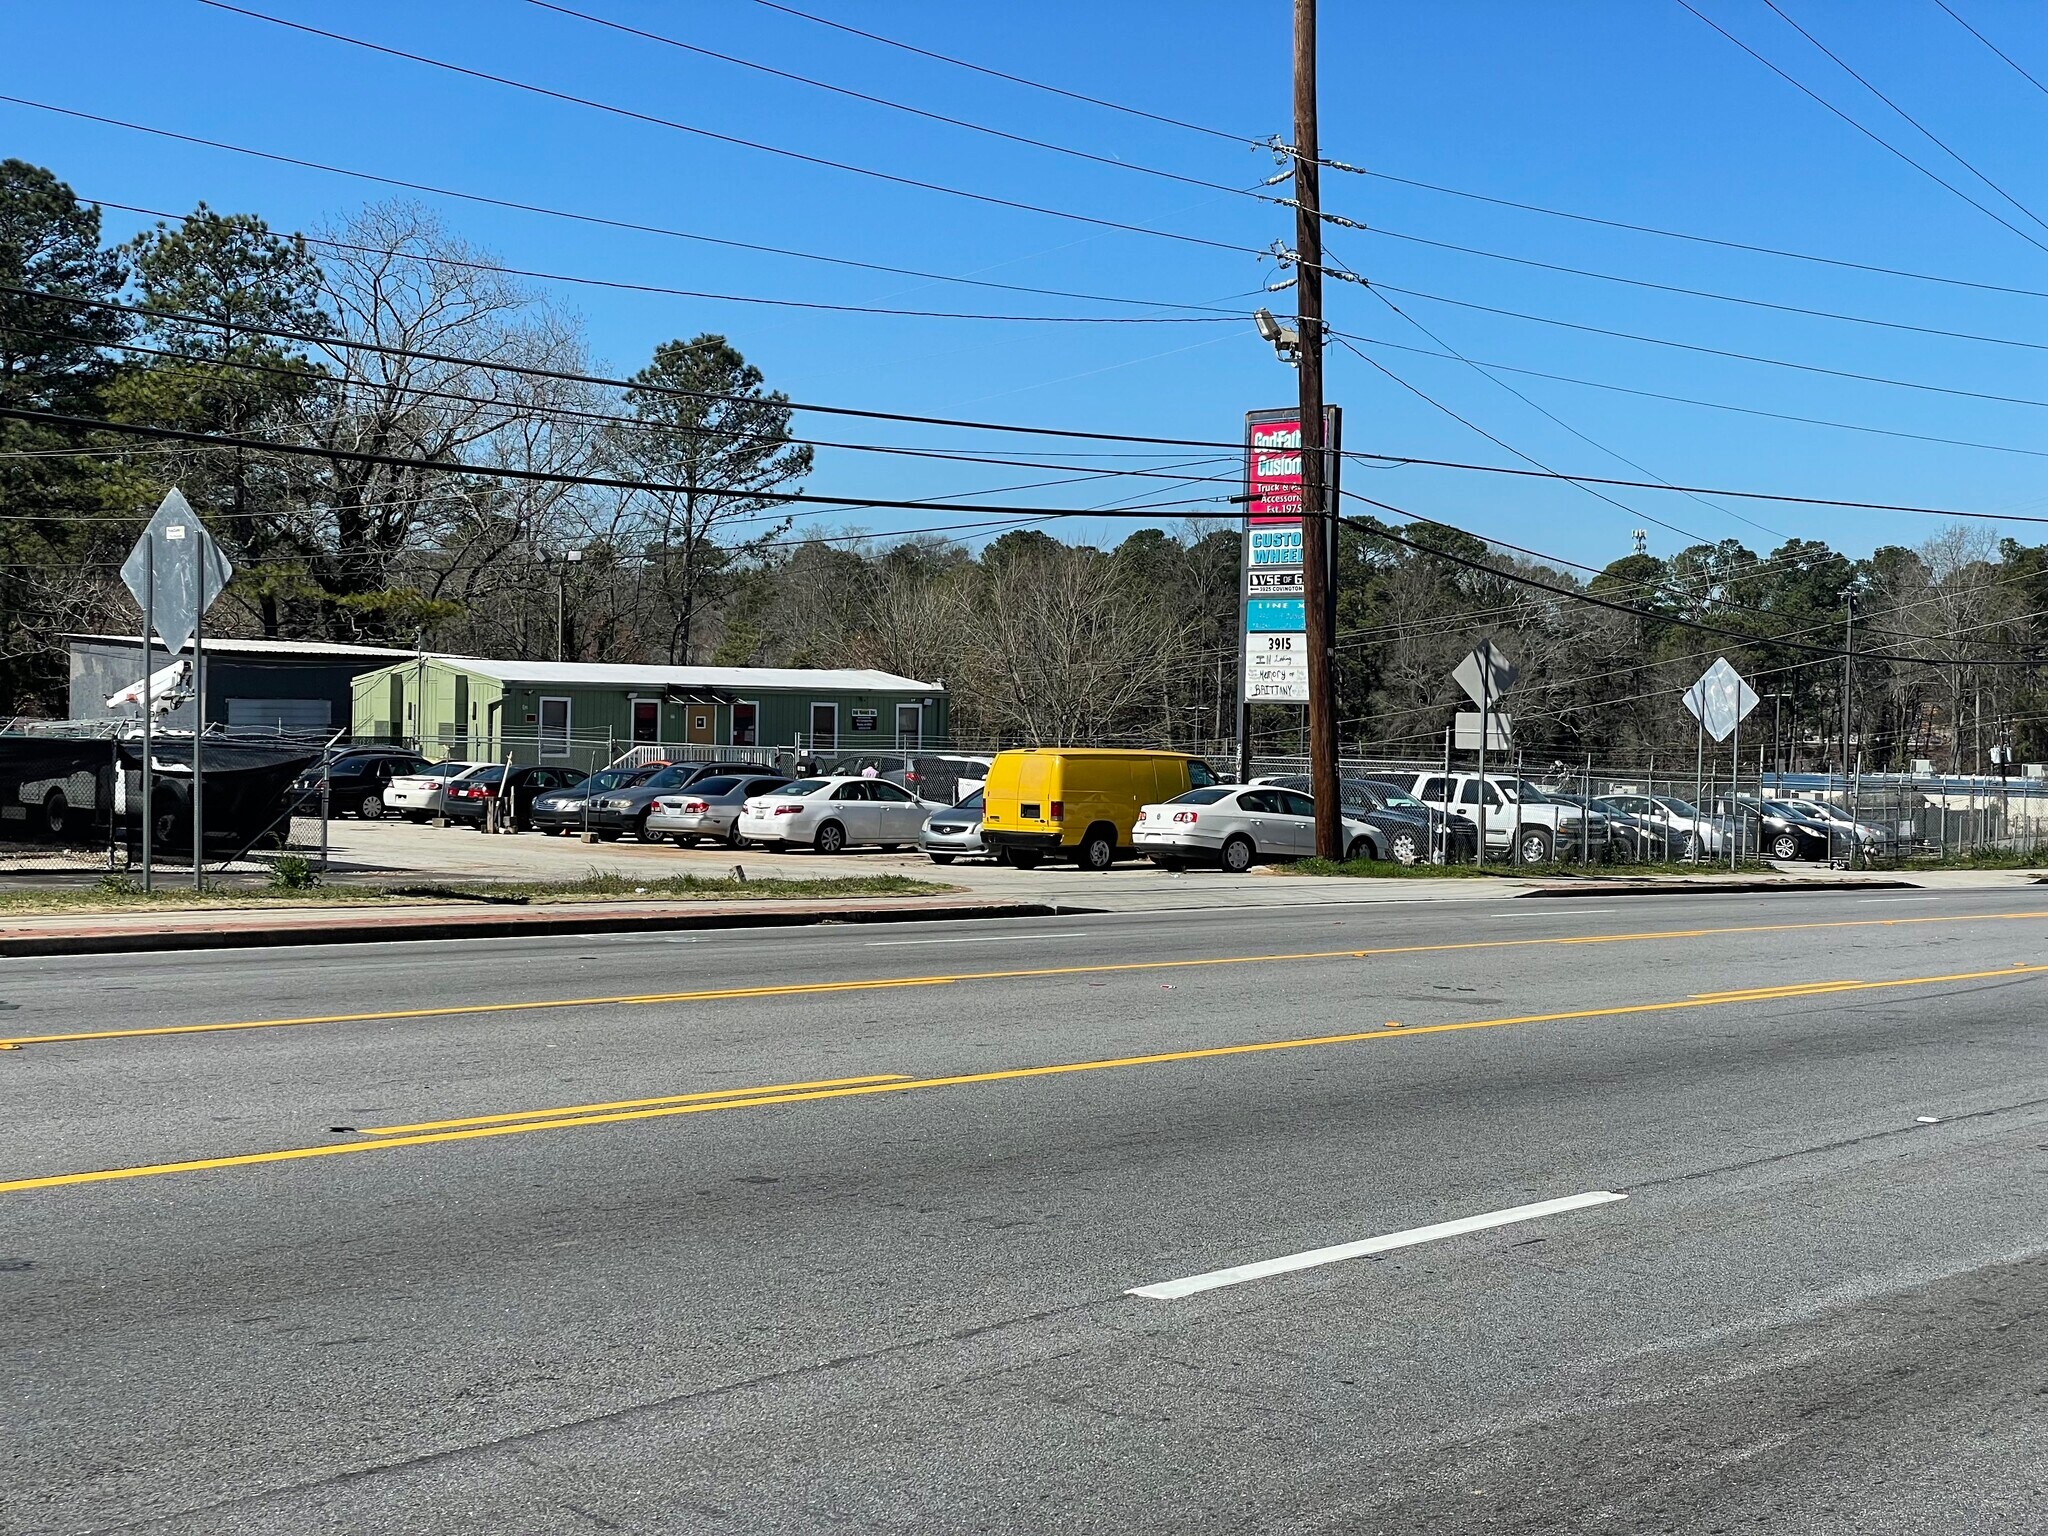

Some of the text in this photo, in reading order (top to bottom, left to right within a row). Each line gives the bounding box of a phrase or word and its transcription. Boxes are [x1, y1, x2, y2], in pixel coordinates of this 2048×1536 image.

[1257, 484, 1279, 492] Truck
[1282, 504, 1302, 513] 1975
[1268, 637, 1291, 650] 3915
